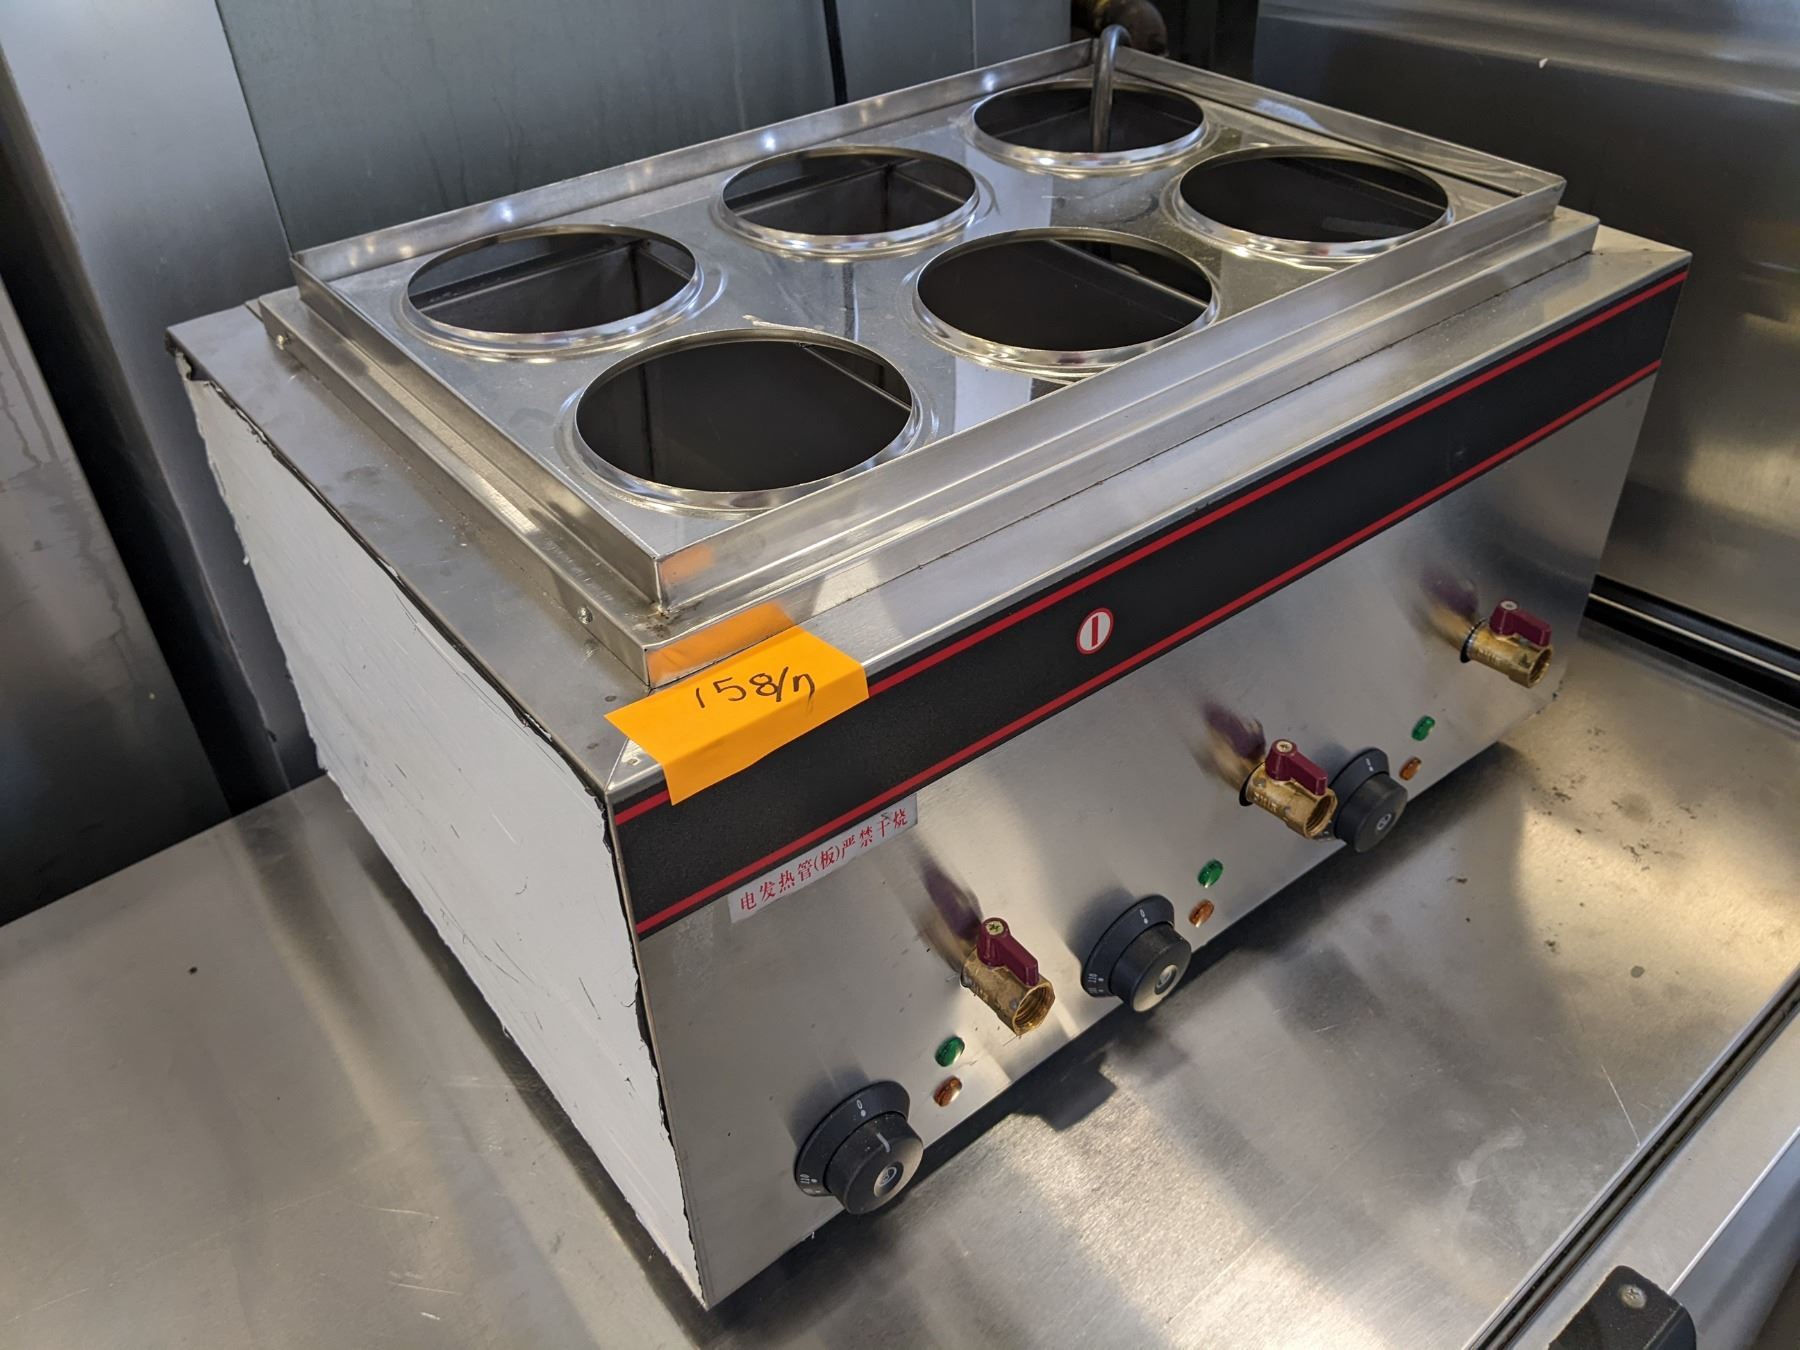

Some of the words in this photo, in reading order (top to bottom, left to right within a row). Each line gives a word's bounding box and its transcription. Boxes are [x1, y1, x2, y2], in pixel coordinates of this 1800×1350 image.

[740, 808, 908, 911] 电发热管(板)严禁干烧
